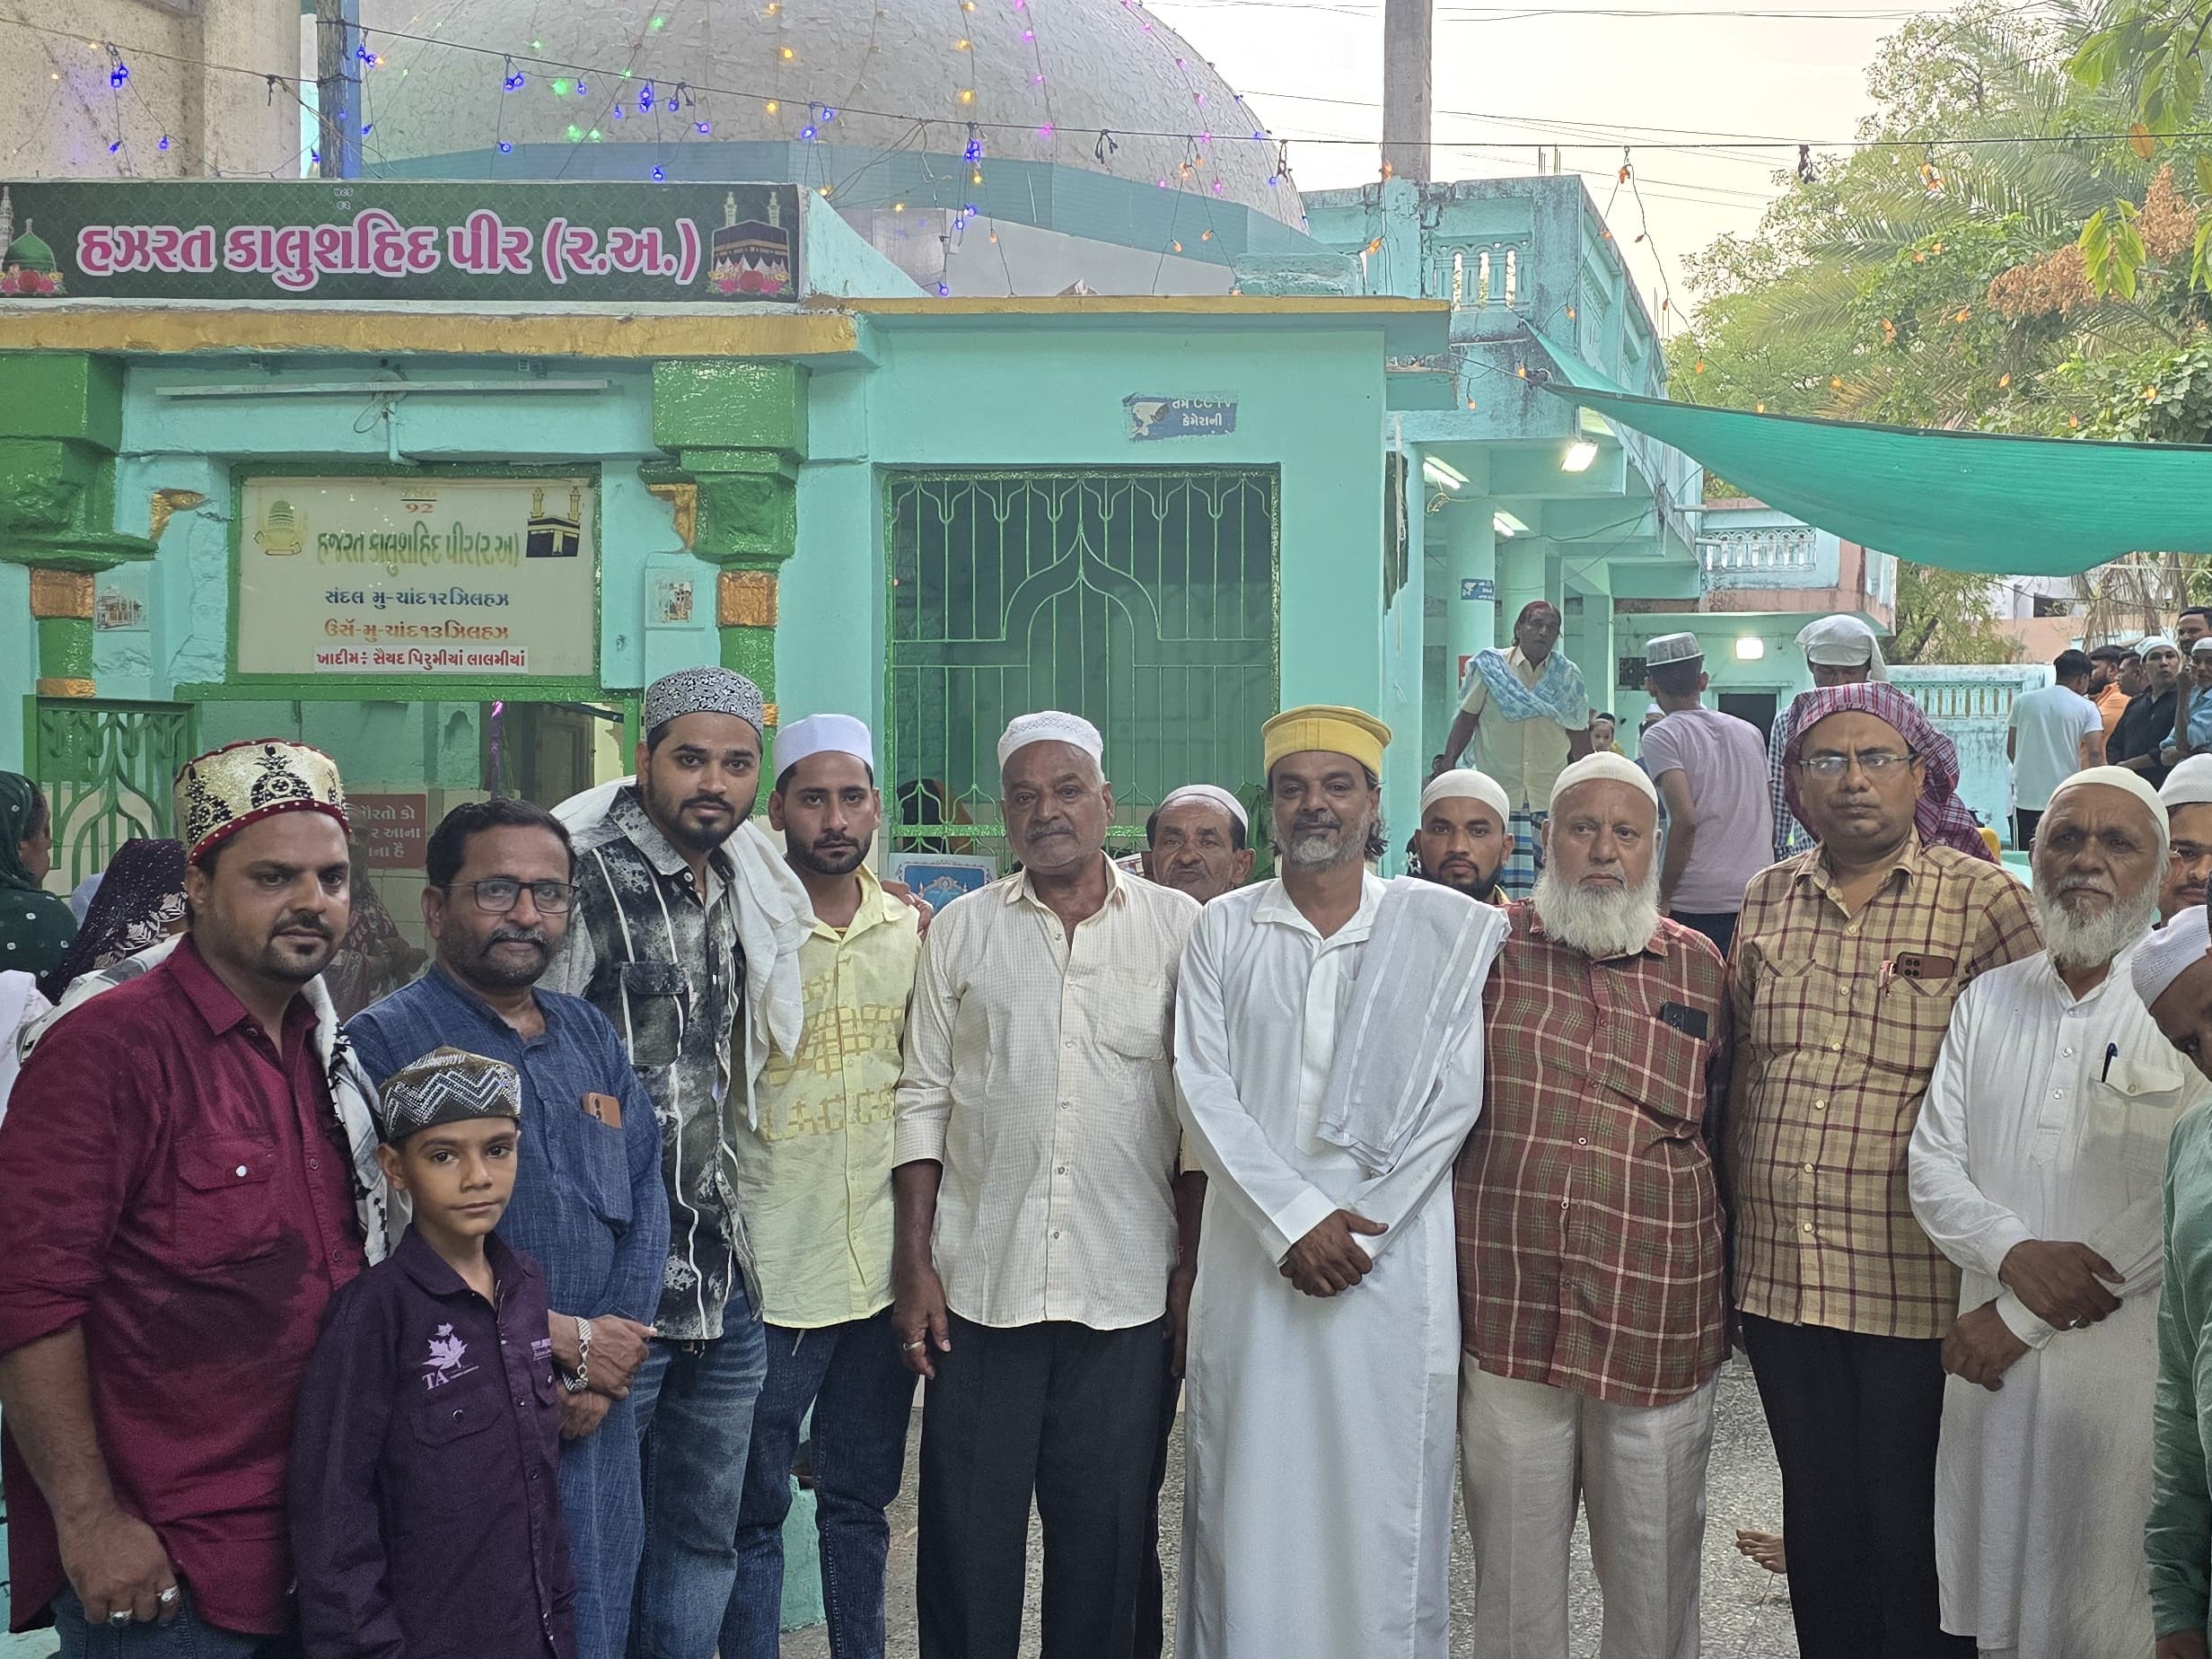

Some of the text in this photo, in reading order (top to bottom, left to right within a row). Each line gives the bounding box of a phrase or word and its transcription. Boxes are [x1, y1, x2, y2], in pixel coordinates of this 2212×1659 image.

[76, 208, 700, 292] હઝરત કાલુશહિદ પીર (ર.અ.)
[405, 503, 434, 514] 92
[318, 531, 364, 565] હજરત
[325, 586, 364, 605] સંદલ
[373, 647, 406, 665] સૈયદ
[467, 649, 525, 666] લાલમીયાં
[422, 1370, 450, 1391] TA
